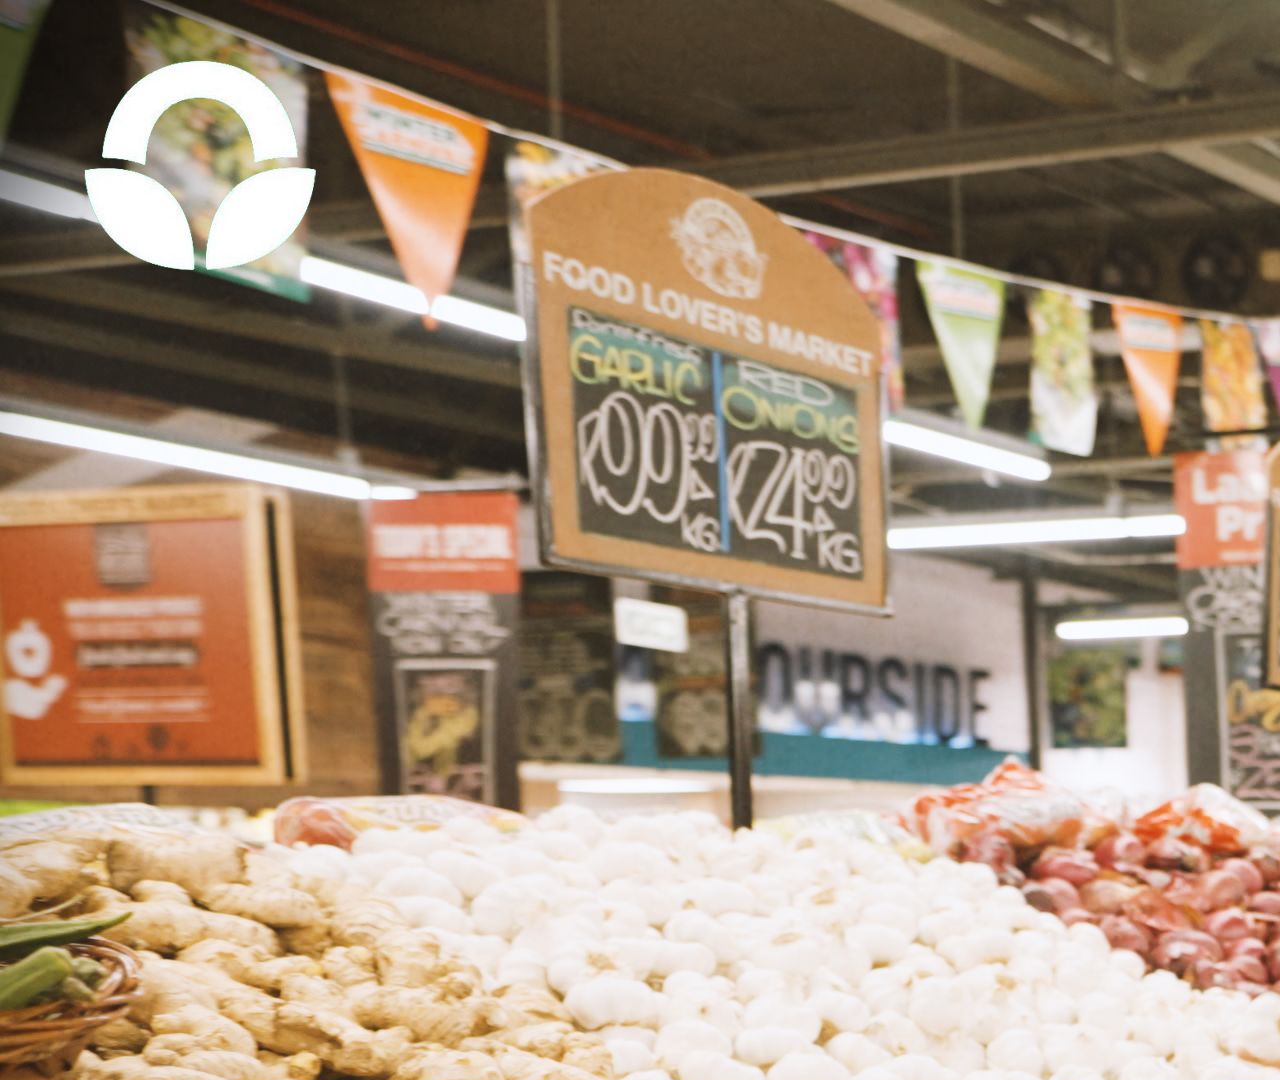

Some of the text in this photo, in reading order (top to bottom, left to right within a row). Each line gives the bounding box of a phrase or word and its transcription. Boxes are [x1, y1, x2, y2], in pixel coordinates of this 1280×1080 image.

[543, 252, 636, 304] FOOD
[643, 282, 762, 346] LOVER'S
[768, 322, 874, 376] MARKET
[571, 335, 700, 405] GARLIC
[737, 359, 834, 406] RED
[721, 386, 861, 454] ONIONS
[818, 532, 863, 574] KG
